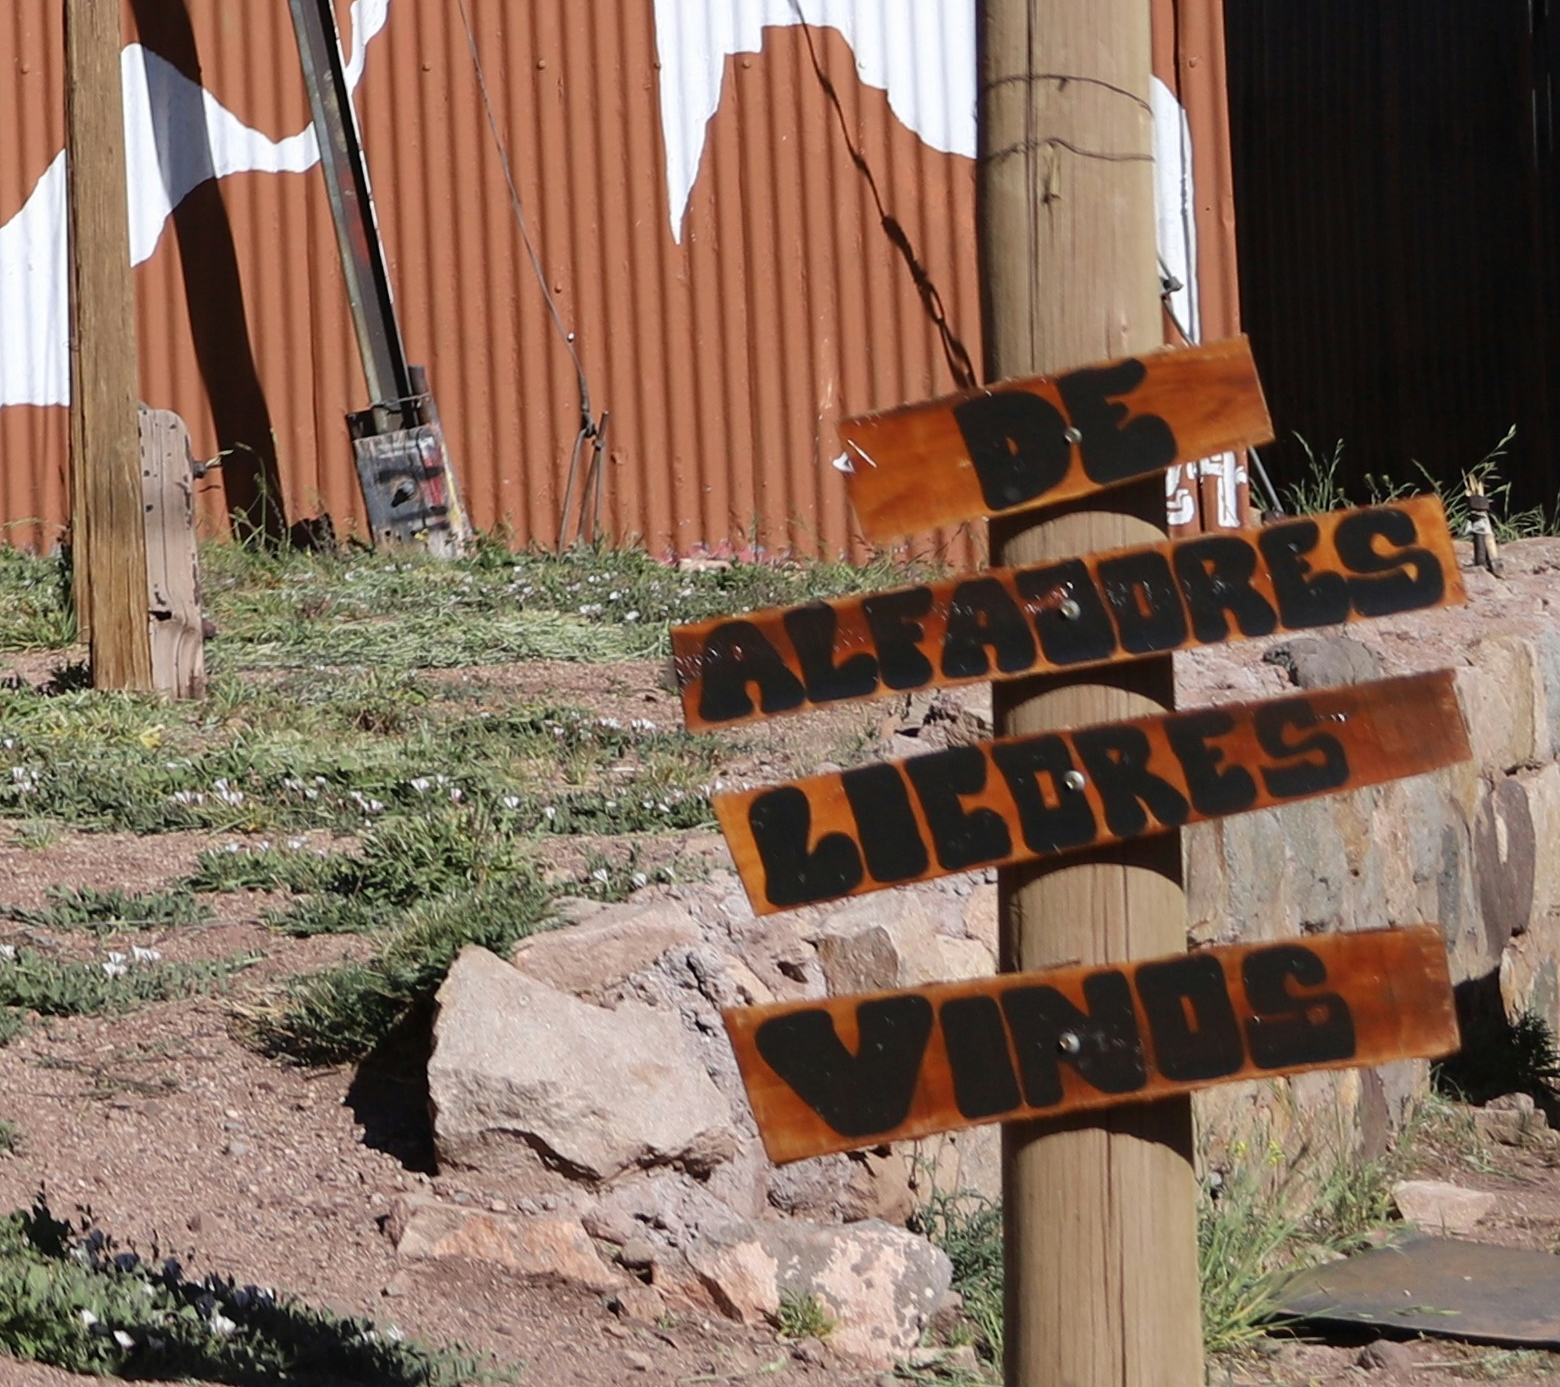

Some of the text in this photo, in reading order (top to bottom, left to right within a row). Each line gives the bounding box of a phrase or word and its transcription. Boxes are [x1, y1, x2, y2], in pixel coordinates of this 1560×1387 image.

[953, 357, 1177, 512] DE
[699, 506, 1445, 723] ALFAJORES
[748, 697, 1350, 907] LICORES
[755, 945, 1356, 1139] VINOS
